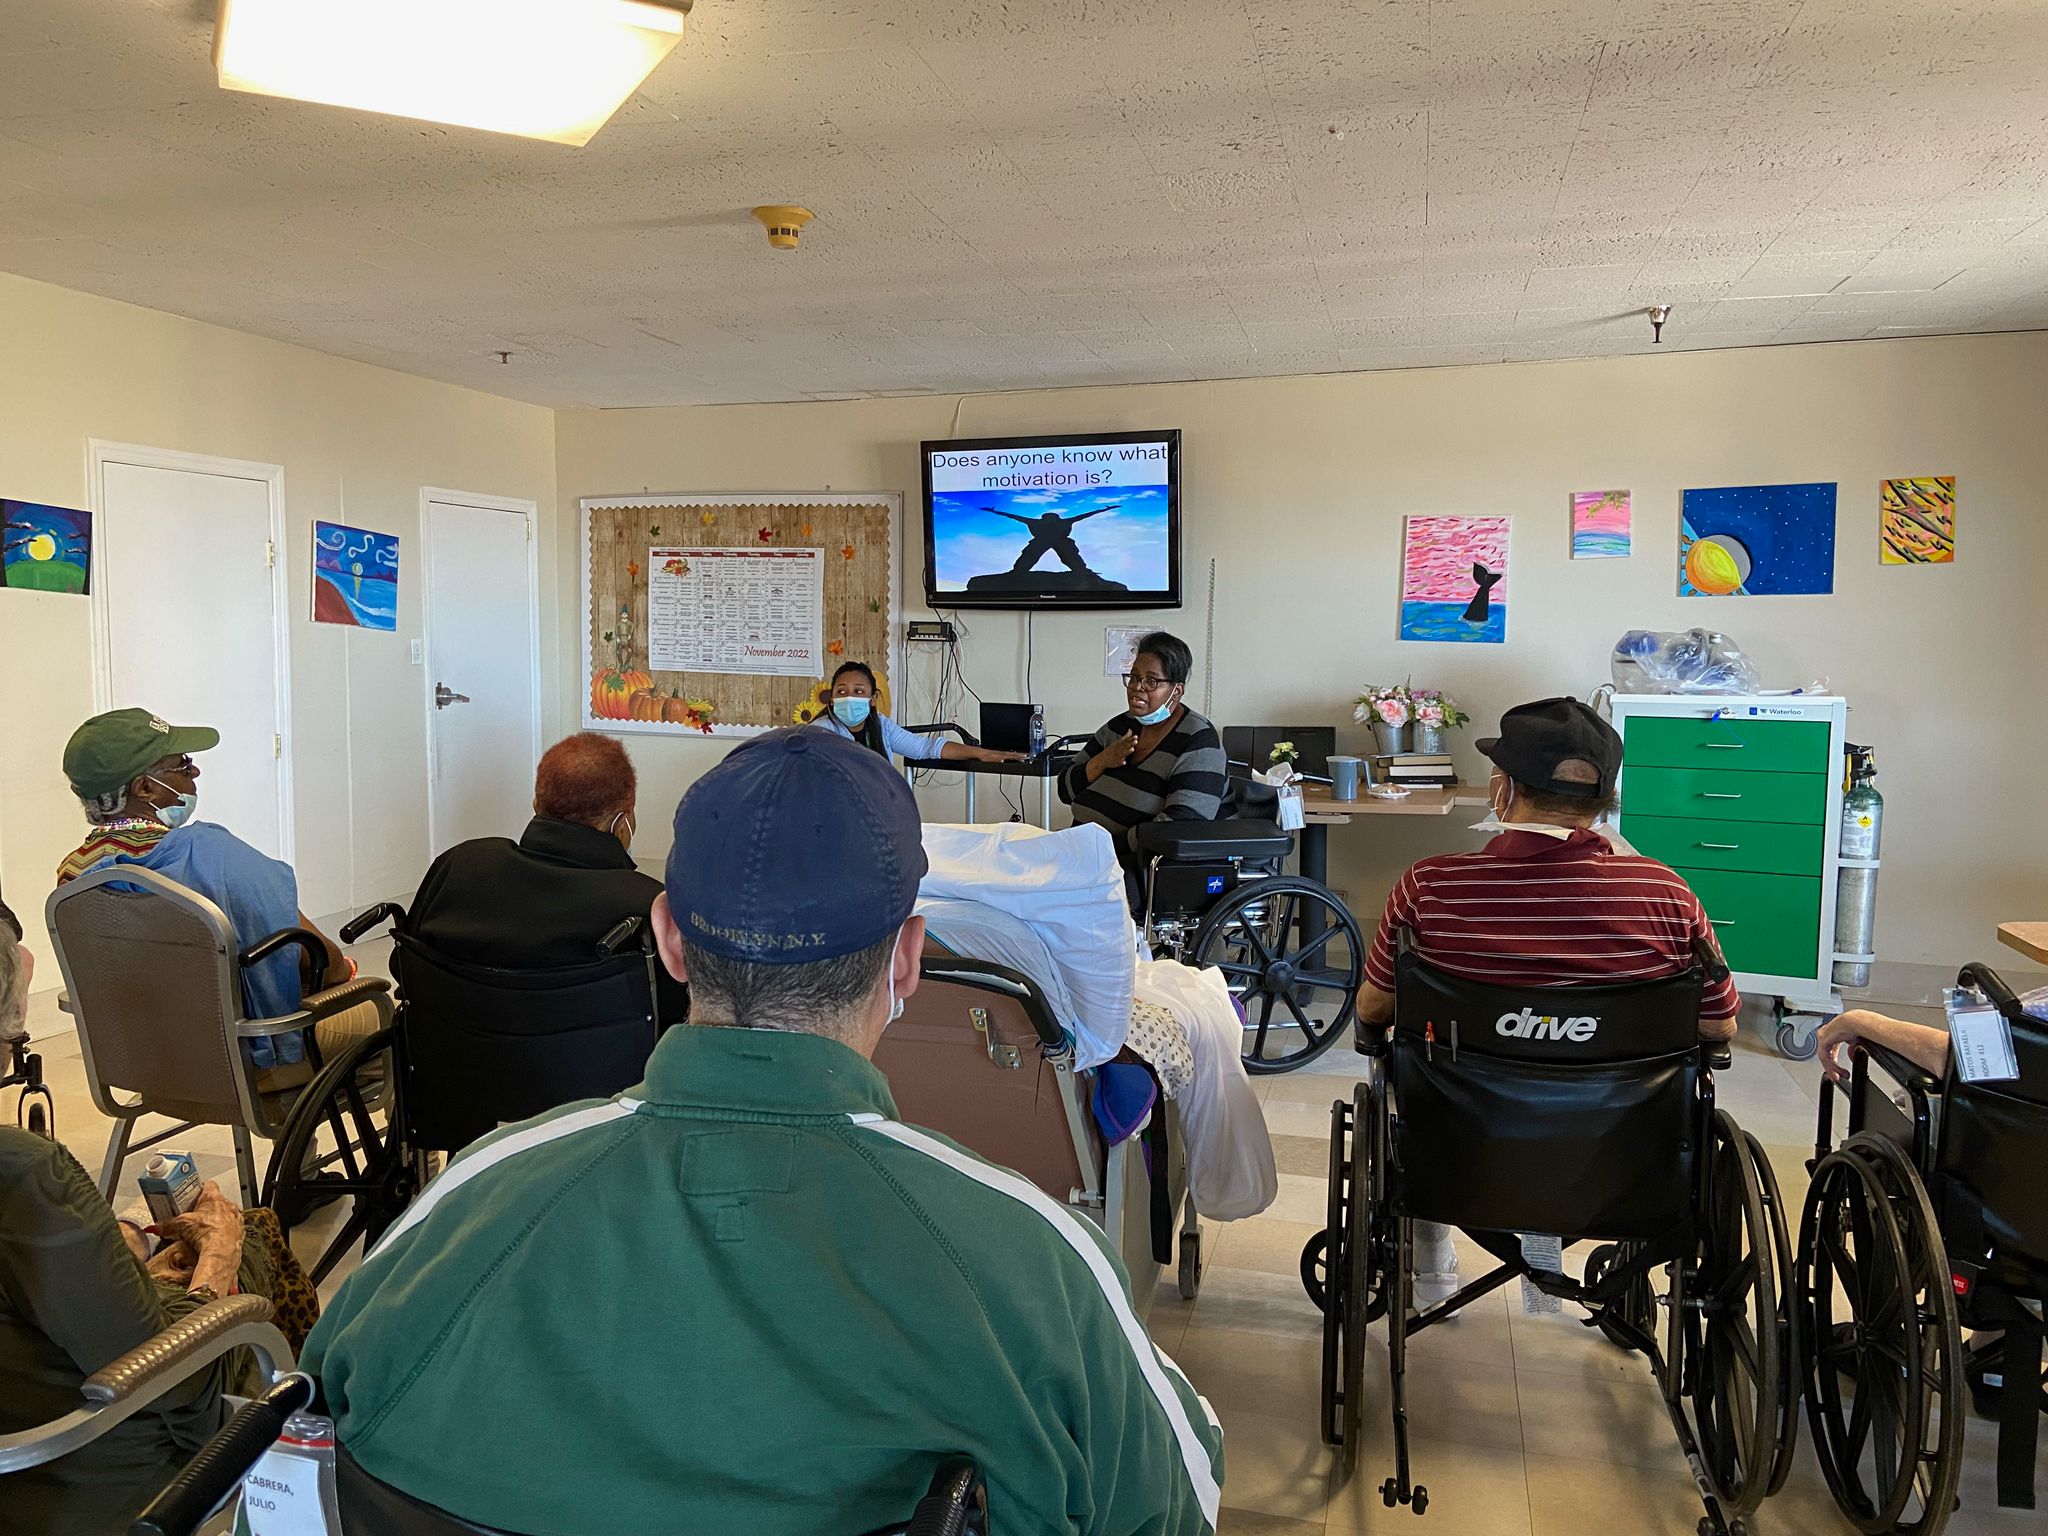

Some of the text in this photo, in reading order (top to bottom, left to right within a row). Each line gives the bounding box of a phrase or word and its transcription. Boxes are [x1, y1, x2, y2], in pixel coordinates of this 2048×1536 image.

[933, 445, 1168, 469] Does anyone know what
[982, 468, 1113, 488] motivation is?
[744, 643, 786, 657] November
[786, 648, 809, 659] 2022
[1769, 708, 1802, 716] Waterloo
[1495, 1007, 1598, 1042] drive
[247, 1474, 294, 1496] CABRERA,
[249, 1496, 276, 1510] JULIO
